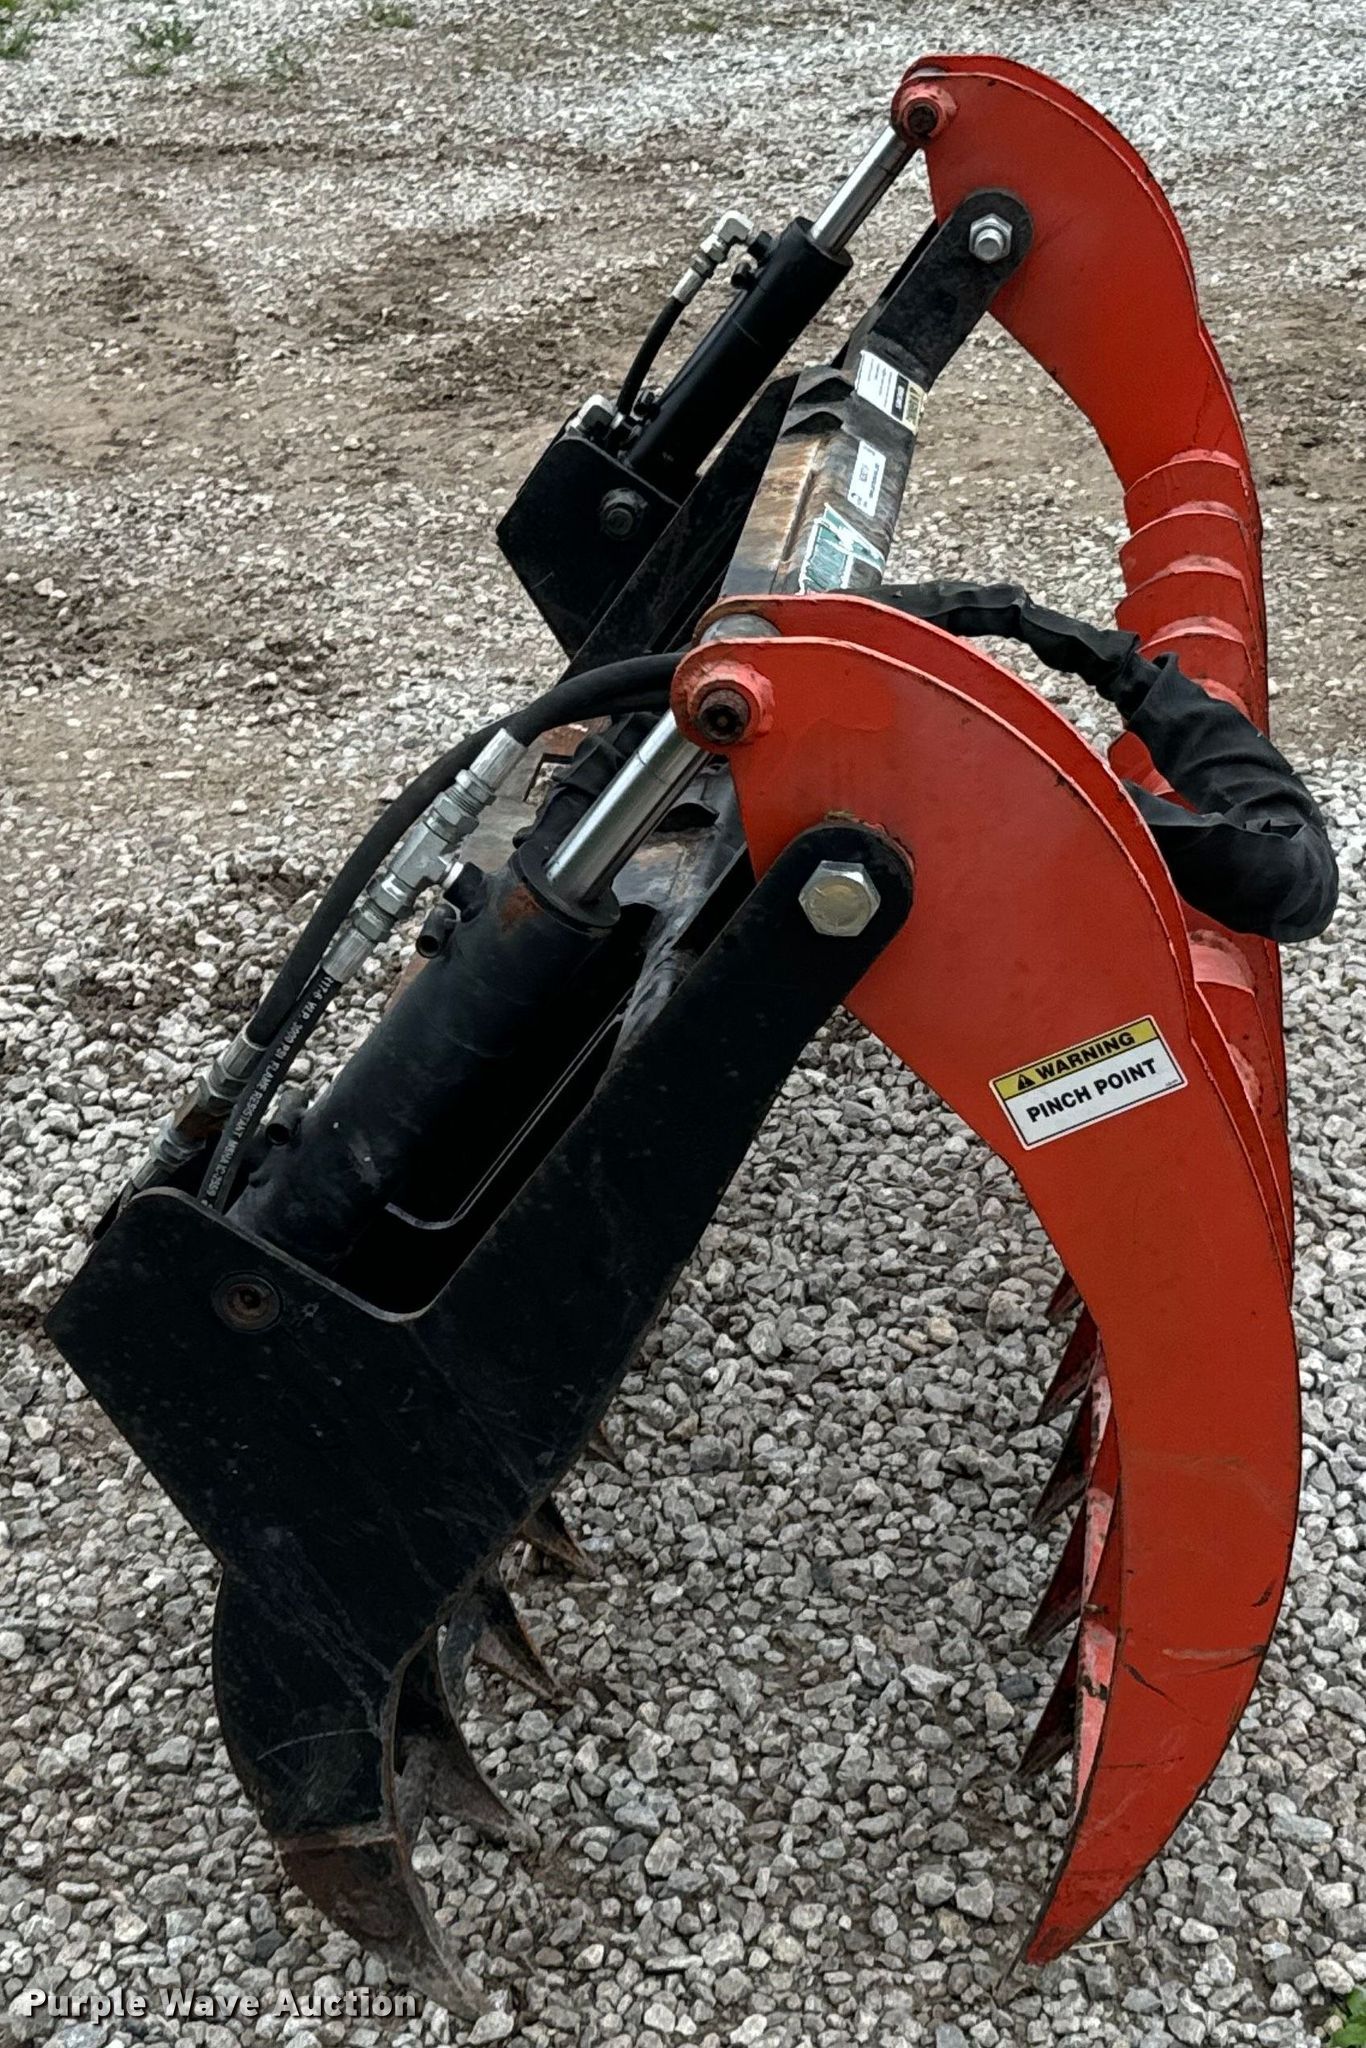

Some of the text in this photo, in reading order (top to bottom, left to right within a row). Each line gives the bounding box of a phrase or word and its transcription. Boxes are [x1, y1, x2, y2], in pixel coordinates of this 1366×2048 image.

[275, 1042, 292, 1060] PSI
[1034, 1031, 1136, 1081] WARNING
[257, 1060, 280, 1092] FLAME
[1026, 1058, 1157, 1122] PINCH POINT
[232, 1090, 264, 1139] RESISTANT
